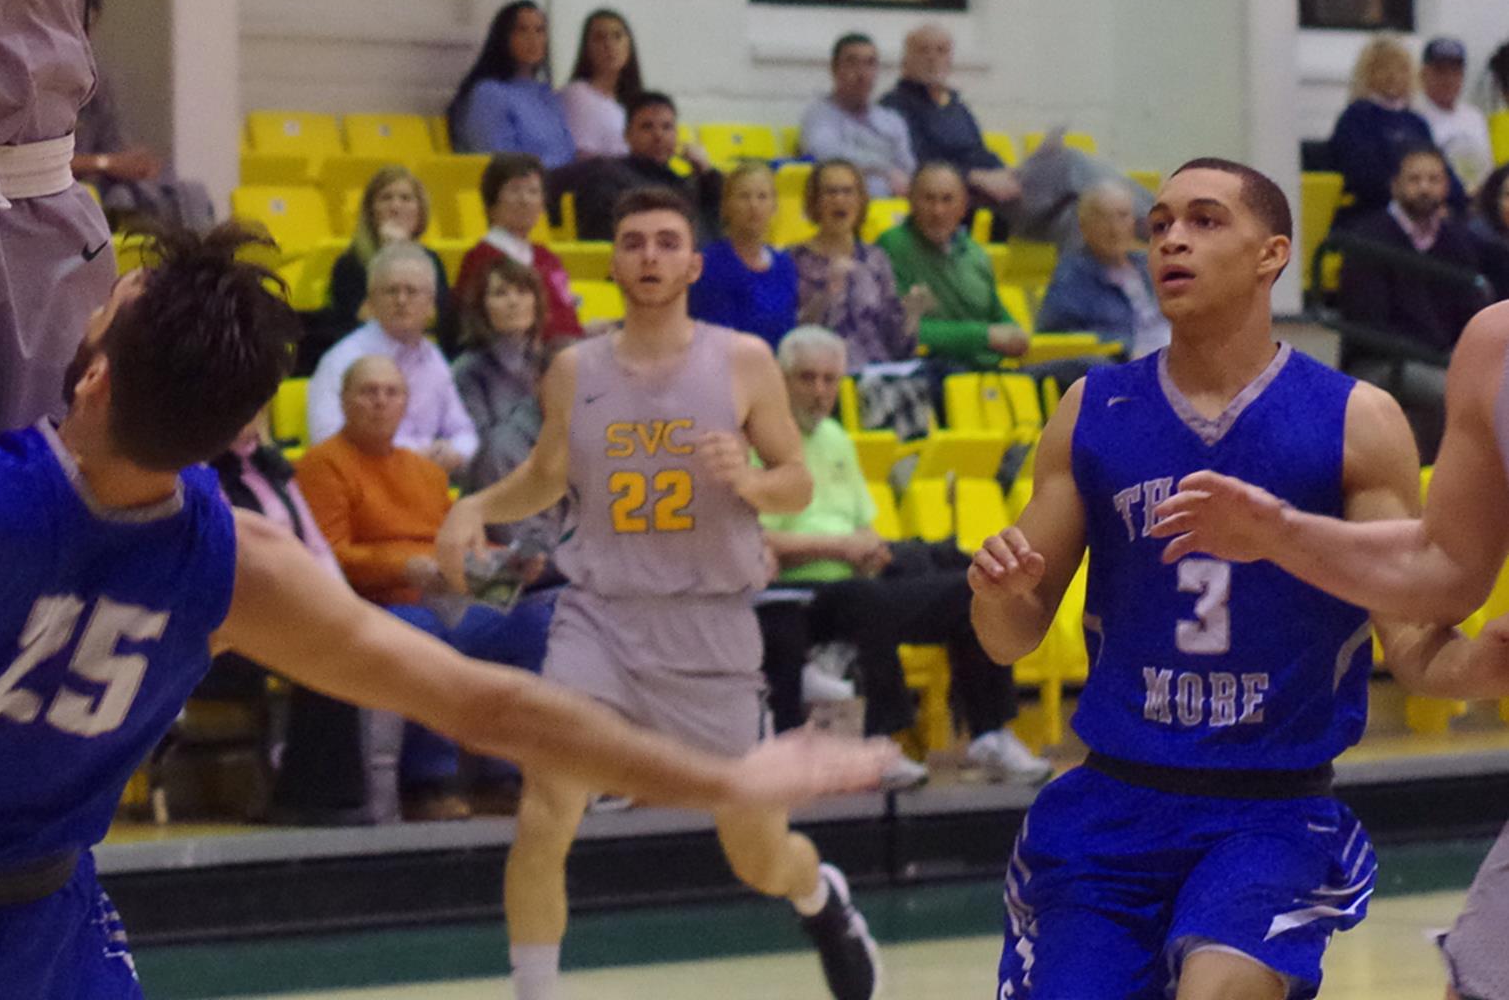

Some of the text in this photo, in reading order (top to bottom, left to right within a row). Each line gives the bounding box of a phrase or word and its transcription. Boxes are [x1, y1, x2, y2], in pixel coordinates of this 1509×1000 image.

[605, 417, 696, 458] SVC
[608, 469, 697, 534] 22
[1176, 557, 1232, 656] 3
[1143, 666, 1270, 728] MORE
